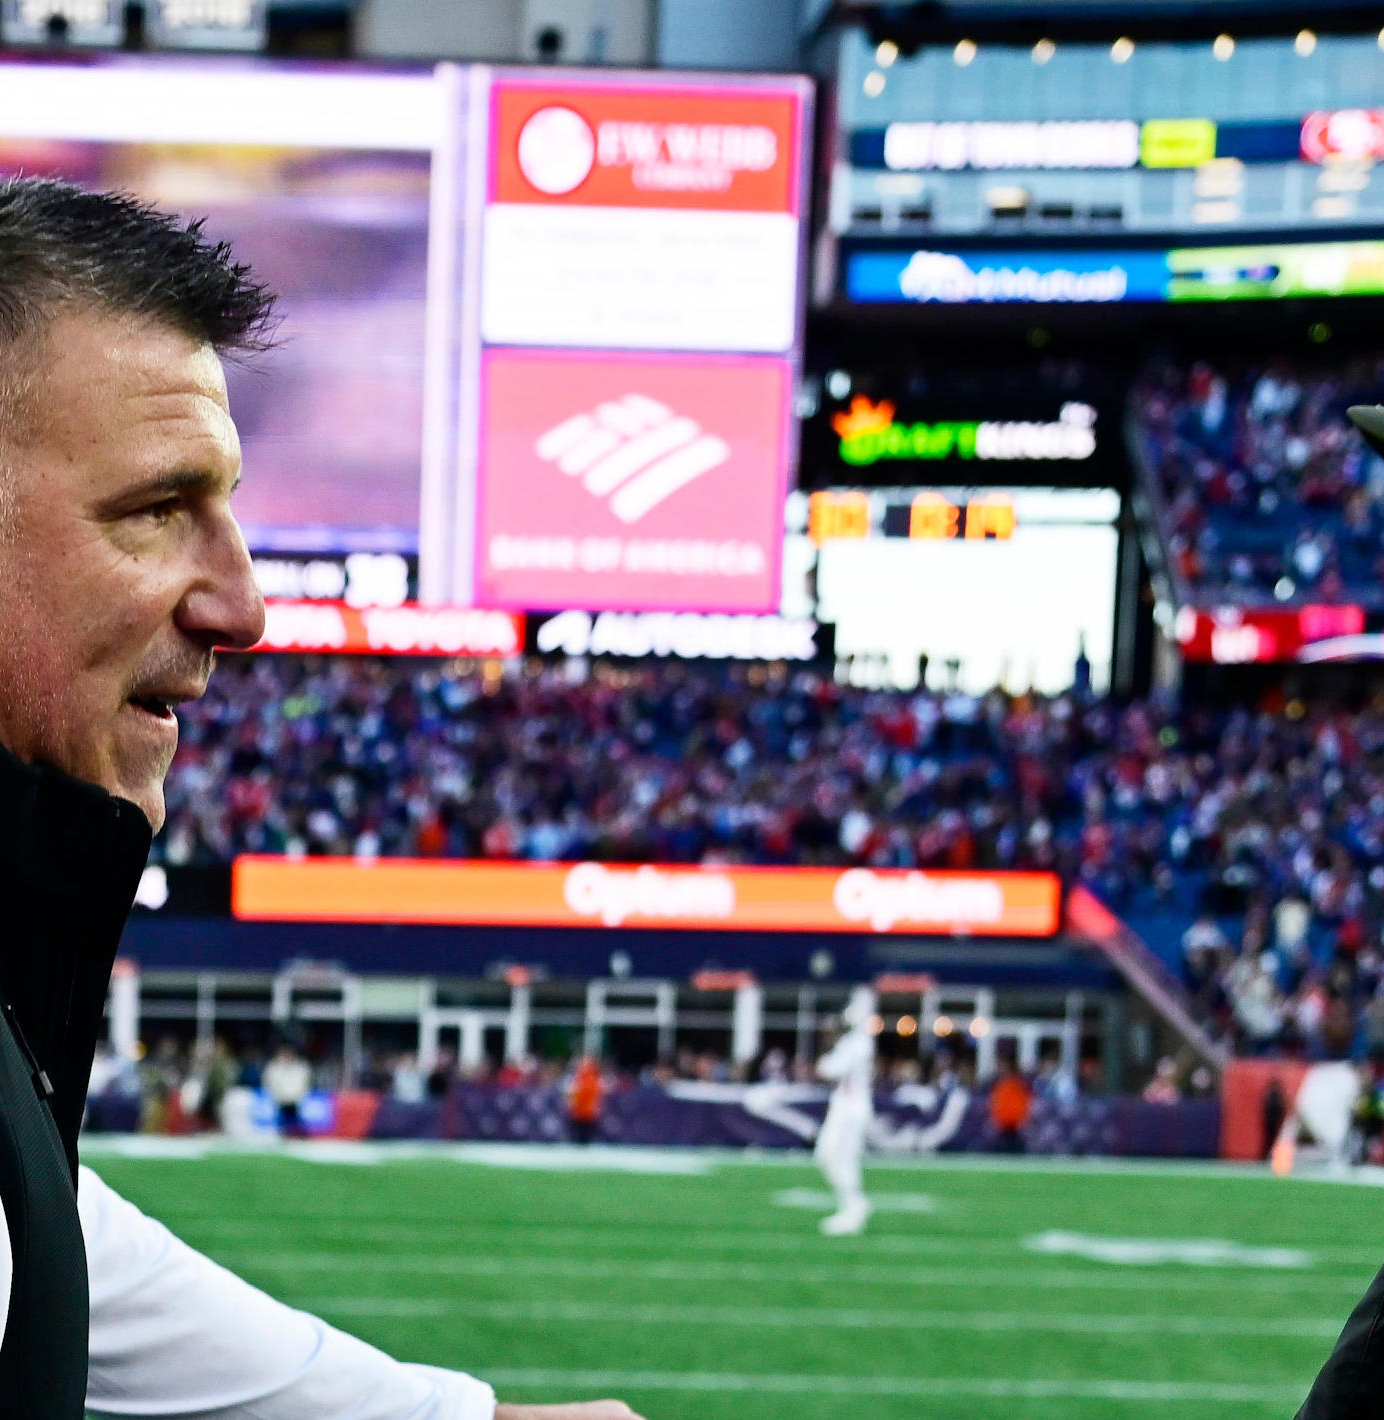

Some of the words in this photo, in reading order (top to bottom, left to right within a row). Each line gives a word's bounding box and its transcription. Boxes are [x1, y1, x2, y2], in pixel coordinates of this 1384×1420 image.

[624, 537, 765, 577] AMERICA
[591, 612, 815, 658] AUTODESK
[564, 861, 735, 927] Optum
[834, 867, 1004, 934] Optum
